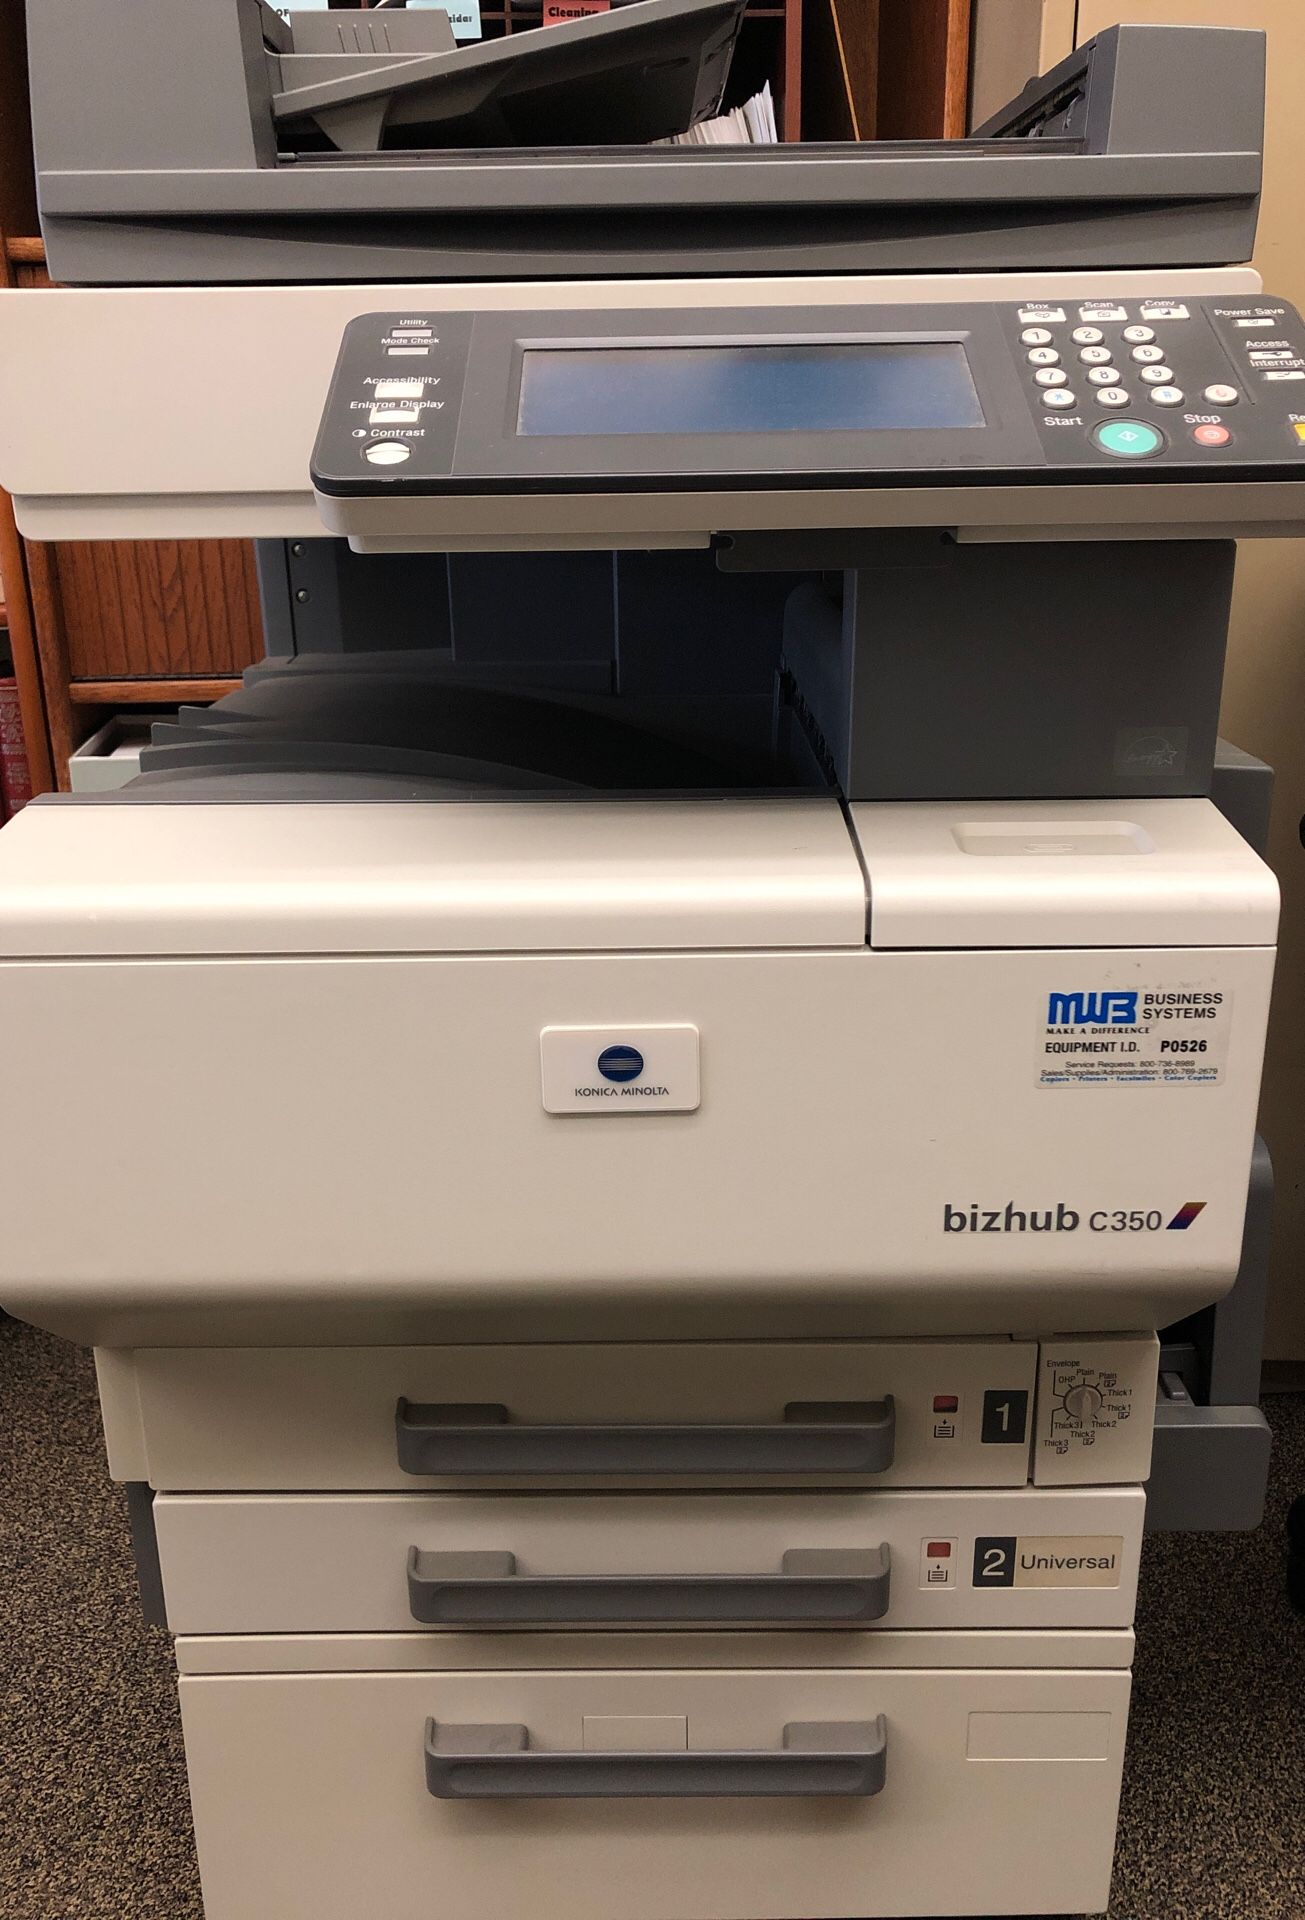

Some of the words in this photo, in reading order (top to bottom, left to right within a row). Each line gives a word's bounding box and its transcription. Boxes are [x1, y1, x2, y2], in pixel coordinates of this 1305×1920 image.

[1026, 302, 1050, 310] Box
[1084, 301, 1114, 309] Scan
[1254, 307, 1286, 316] Save
[1245, 340, 1290, 348] Access
[1249, 359, 1305, 368] Interrupt
[363, 376, 441, 386] Accessibility
[350, 401, 396, 410] Enlarge
[400, 400, 445, 410] Display
[1044, 415, 1084, 426] Start
[1184, 413, 1221, 424] Stop
[370, 428, 426, 437] Contrast
[1047, 991, 1138, 1025] MWB
[1143, 993, 1223, 1006] BUSINESS
[1142, 1007, 1217, 1019] SYSTEMS
[1046, 1027, 1076, 1035] MAKE
[1079, 1027, 1087, 1035] A
[1091, 1026, 1150, 1035] DIFFERENCE
[1045, 1041, 1117, 1054] EQUIPMENT
[1119, 1041, 1140, 1053] I.D.
[1160, 1039, 1207, 1053] P0526
[1065, 1061, 1096, 1069] Service
[574, 1087, 619, 1097] KONICA
[620, 1086, 670, 1096] MINOLTA
[943, 1199, 1080, 1232] bizhub
[1089, 1210, 1162, 1232] C350
[1047, 1359, 1080, 1369] Envelope
[1076, 1368, 1095, 1376] Plain
[1058, 1375, 1076, 1384] OHP
[995, 1402, 1010, 1432] 1
[981, 1548, 1006, 1577] 2
[1020, 1554, 1116, 1570] Universal
